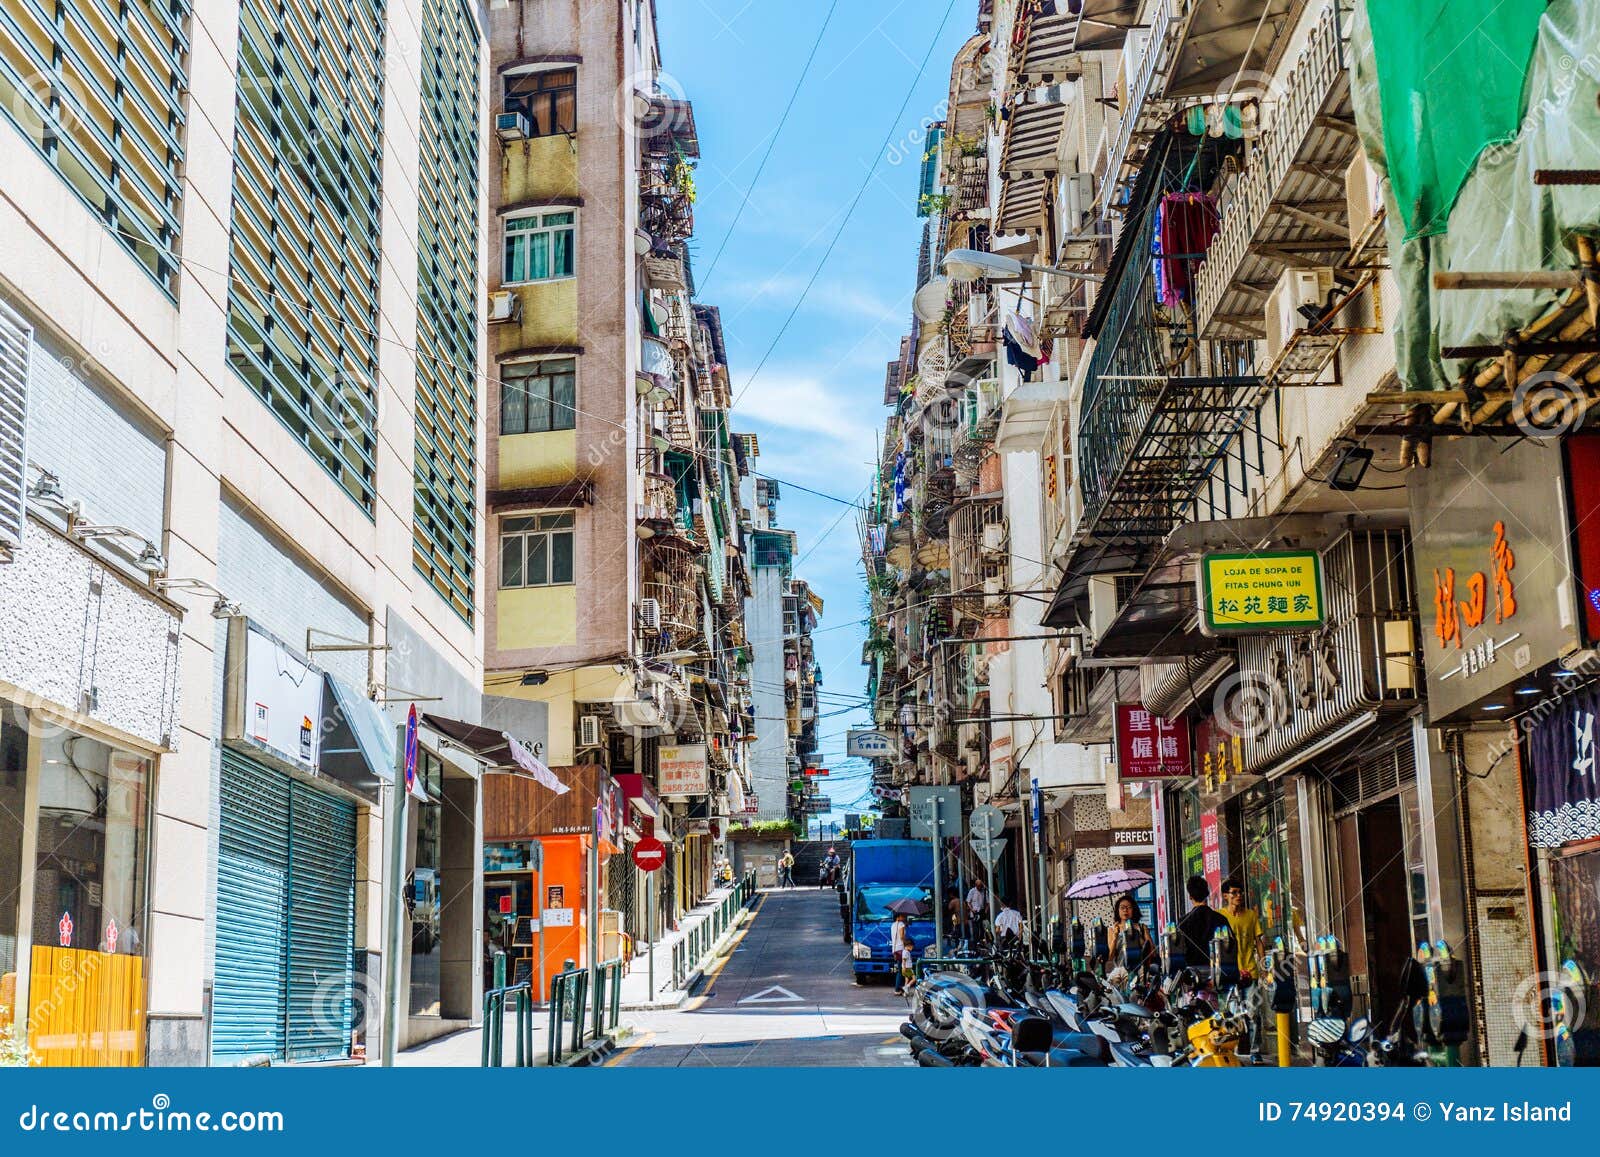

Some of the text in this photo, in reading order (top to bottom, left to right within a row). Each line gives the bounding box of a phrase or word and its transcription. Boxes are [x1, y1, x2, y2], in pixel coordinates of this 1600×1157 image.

[1224, 568, 1246, 576] LOJA
[1249, 567, 1260, 575] DE
[1290, 566, 1302, 574] DE
[1225, 582, 1248, 590] FITAS
[1252, 581, 1283, 589] CHUNG
[1218, 594, 1312, 615] 松苑麵家
[519, 740, 543, 755] se
[1114, 830, 1154, 844] PERFECT
